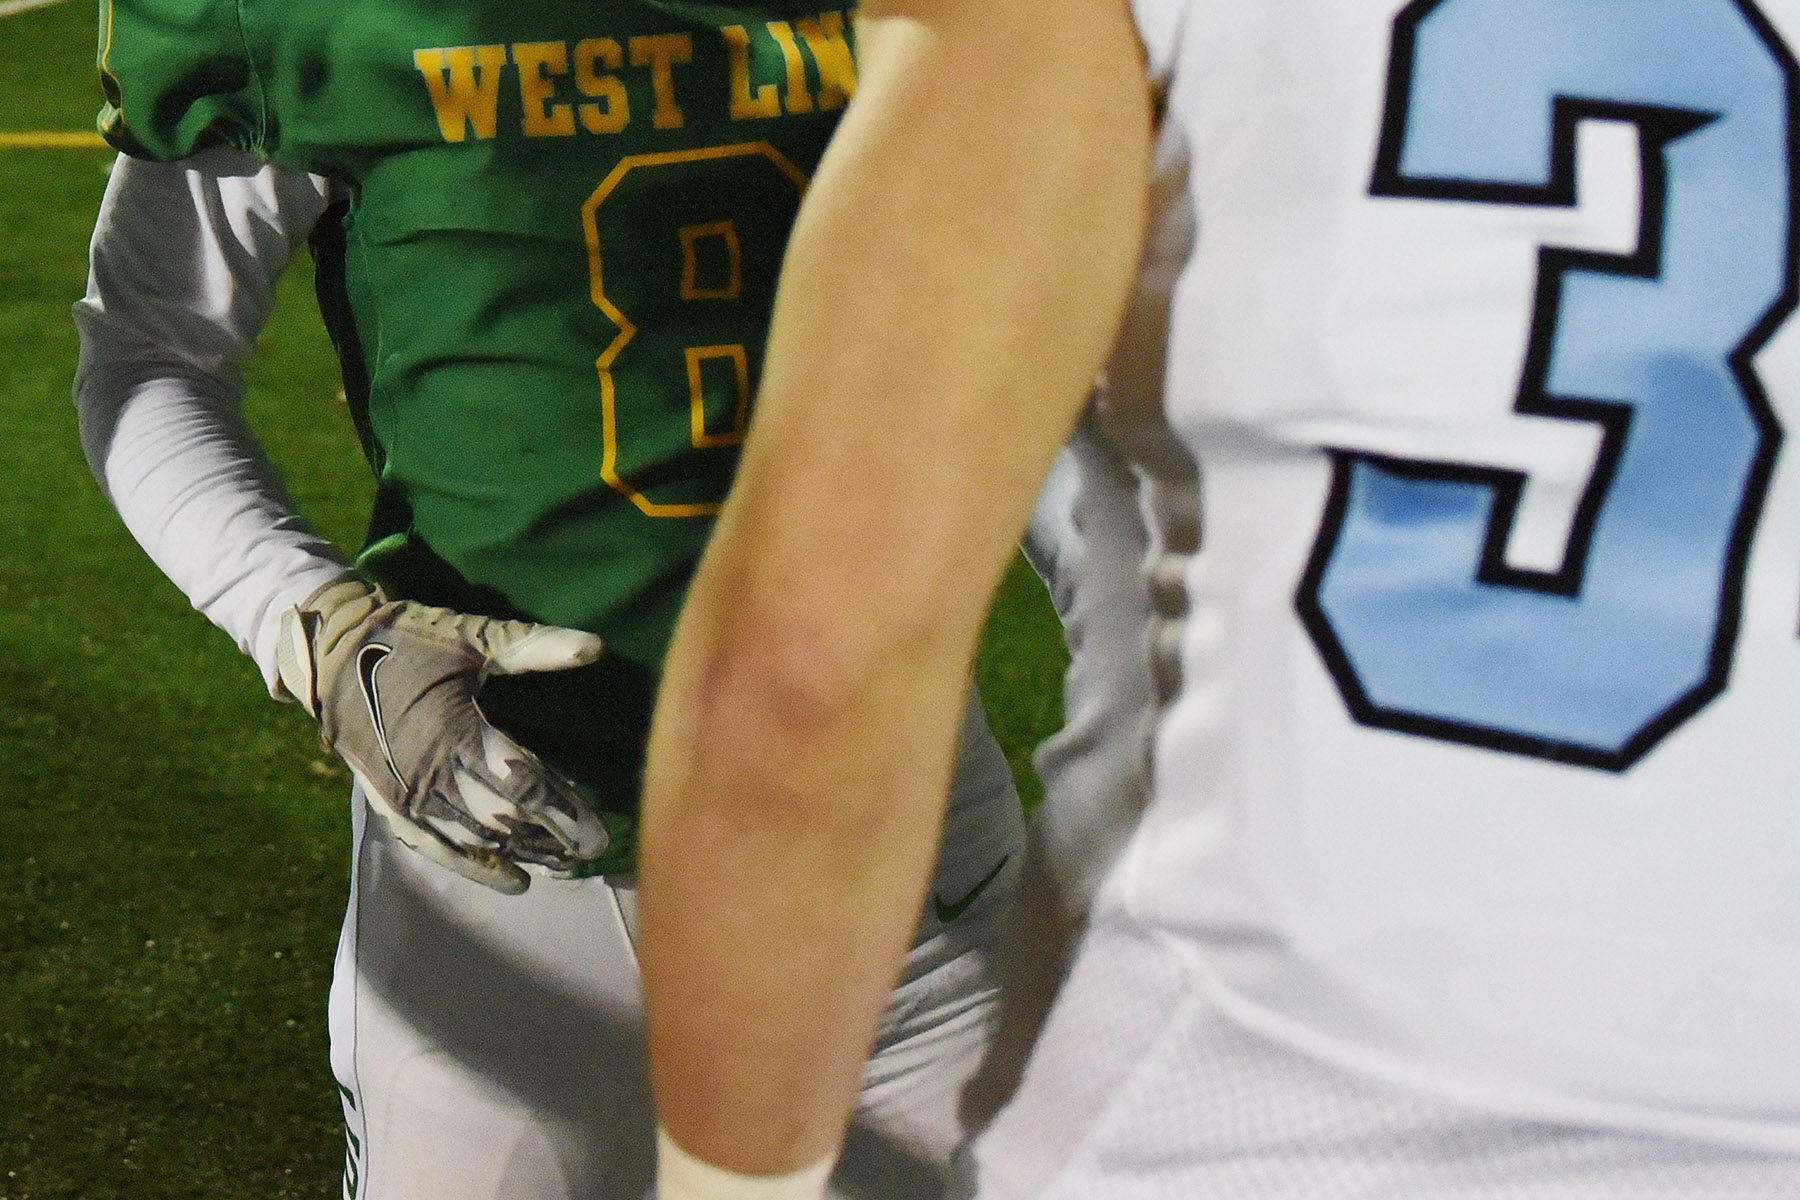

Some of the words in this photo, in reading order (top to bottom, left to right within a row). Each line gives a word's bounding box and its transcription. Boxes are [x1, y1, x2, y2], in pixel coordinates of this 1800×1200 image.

[413, 33, 693, 143] WEST
[721, 9, 858, 121] LIN
[580, 140, 812, 518] 8
